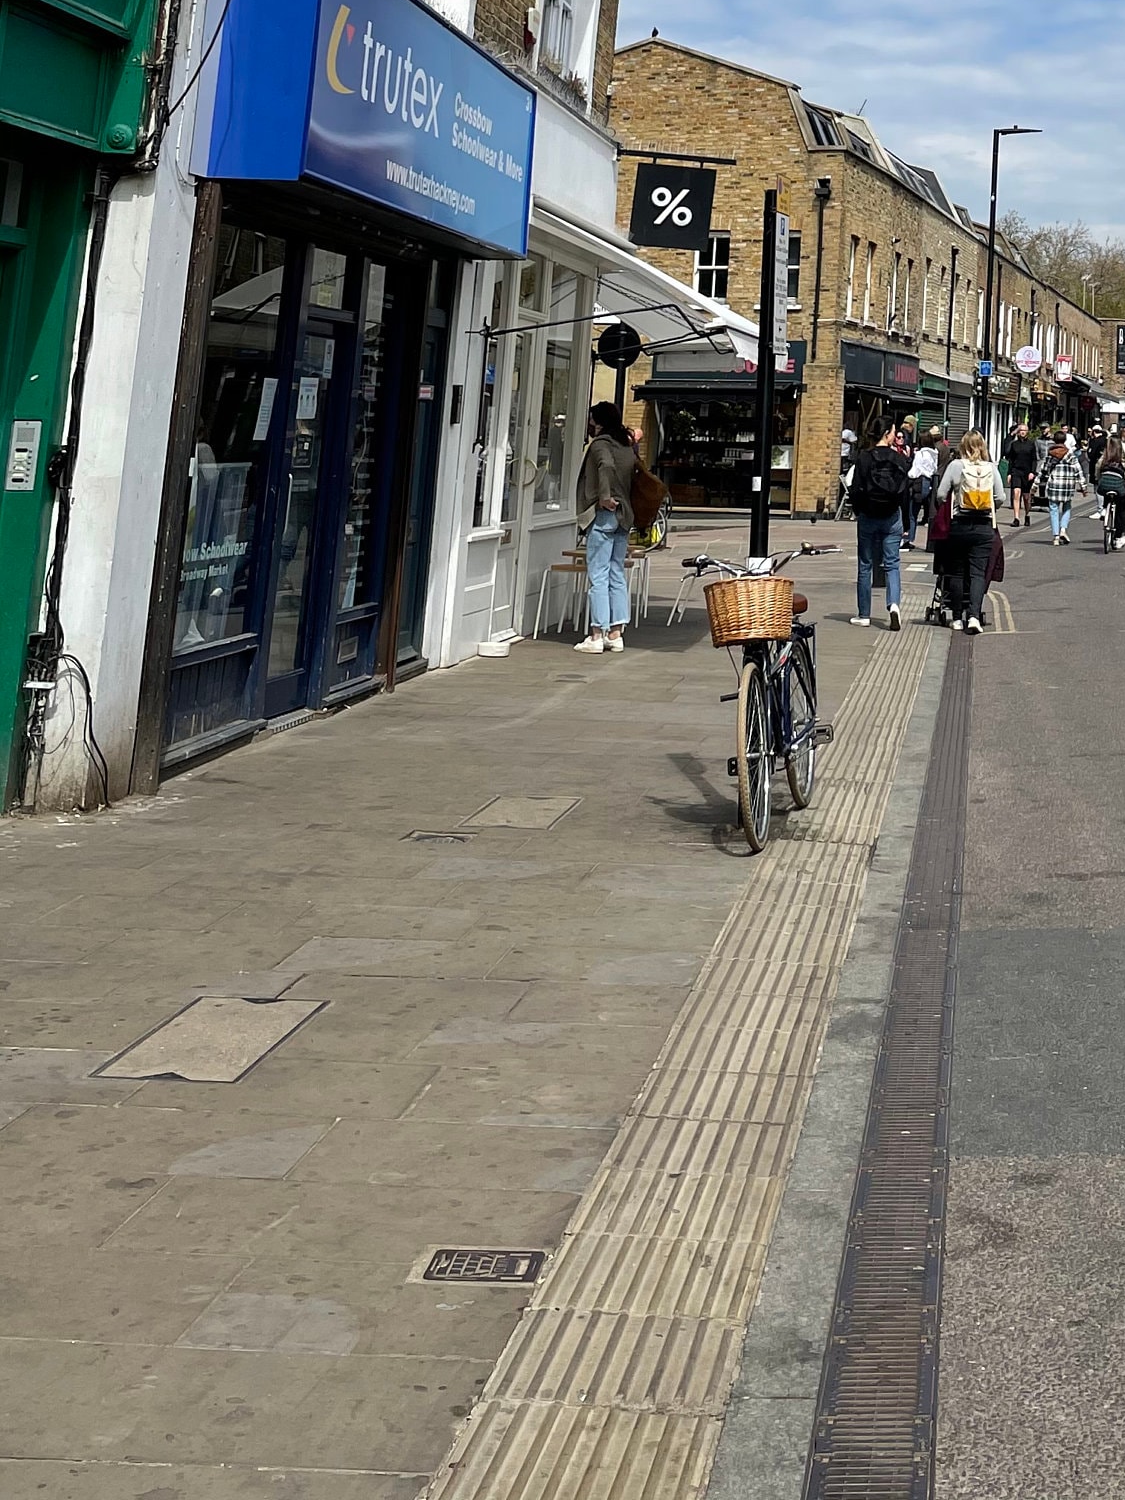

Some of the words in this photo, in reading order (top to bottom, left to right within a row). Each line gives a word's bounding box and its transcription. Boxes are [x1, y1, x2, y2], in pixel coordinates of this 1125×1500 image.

[361, 20, 444, 138] trutex
[454, 91, 494, 137] Crossbow
[451, 123, 498, 163] Schoolwear
[497, 151, 505, 173] &
[505, 152, 524, 183] More
[386, 159, 476, 216] www.trutexhackney.com
[200, 541, 249, 560] Schoolwear
